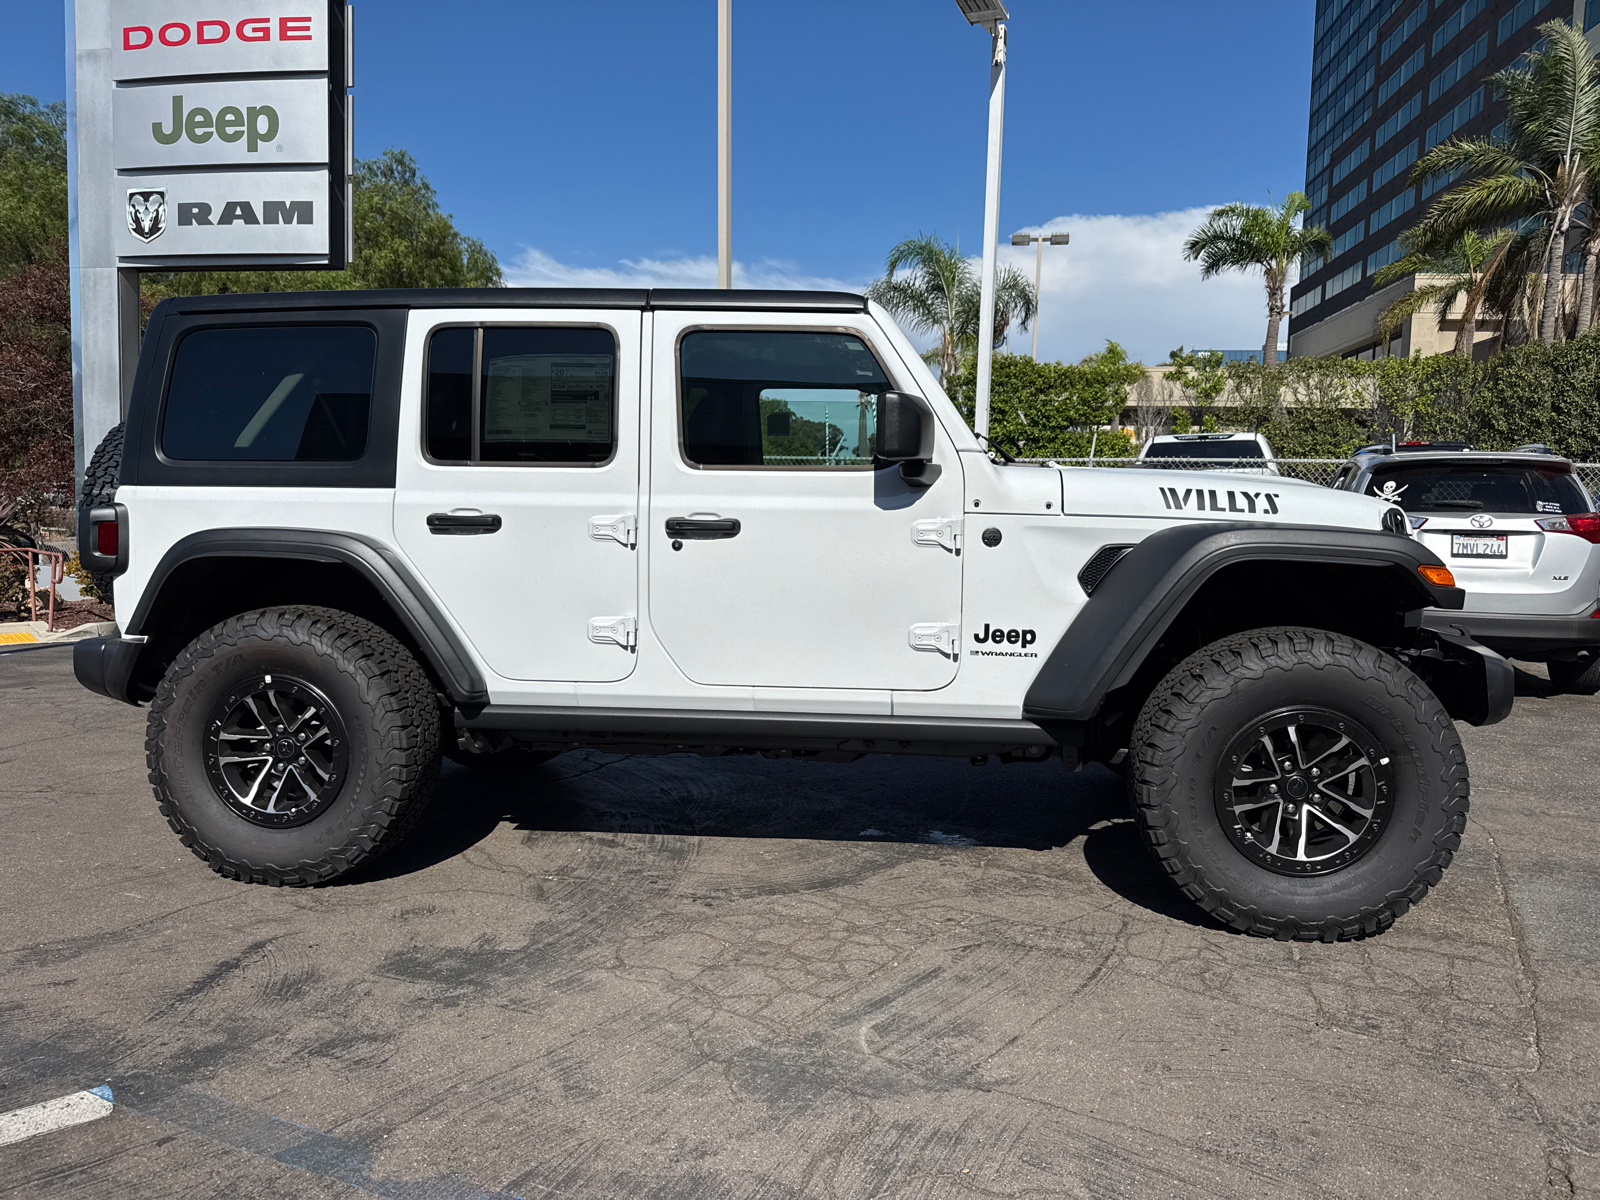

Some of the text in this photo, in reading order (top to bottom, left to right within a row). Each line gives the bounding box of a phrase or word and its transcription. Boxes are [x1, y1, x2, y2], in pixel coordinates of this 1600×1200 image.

[122, 16, 313, 50] DODGE
[151, 95, 280, 153] Jeep
[177, 200, 314, 226] RAM
[1158, 486, 1280, 515] WILLYS
[1455, 542, 1504, 555] 7MVL244
[973, 623, 1037, 648] Jeep
[980, 650, 1038, 658] WRANGLER
[1361, 693, 1432, 846] BFGoodrich
